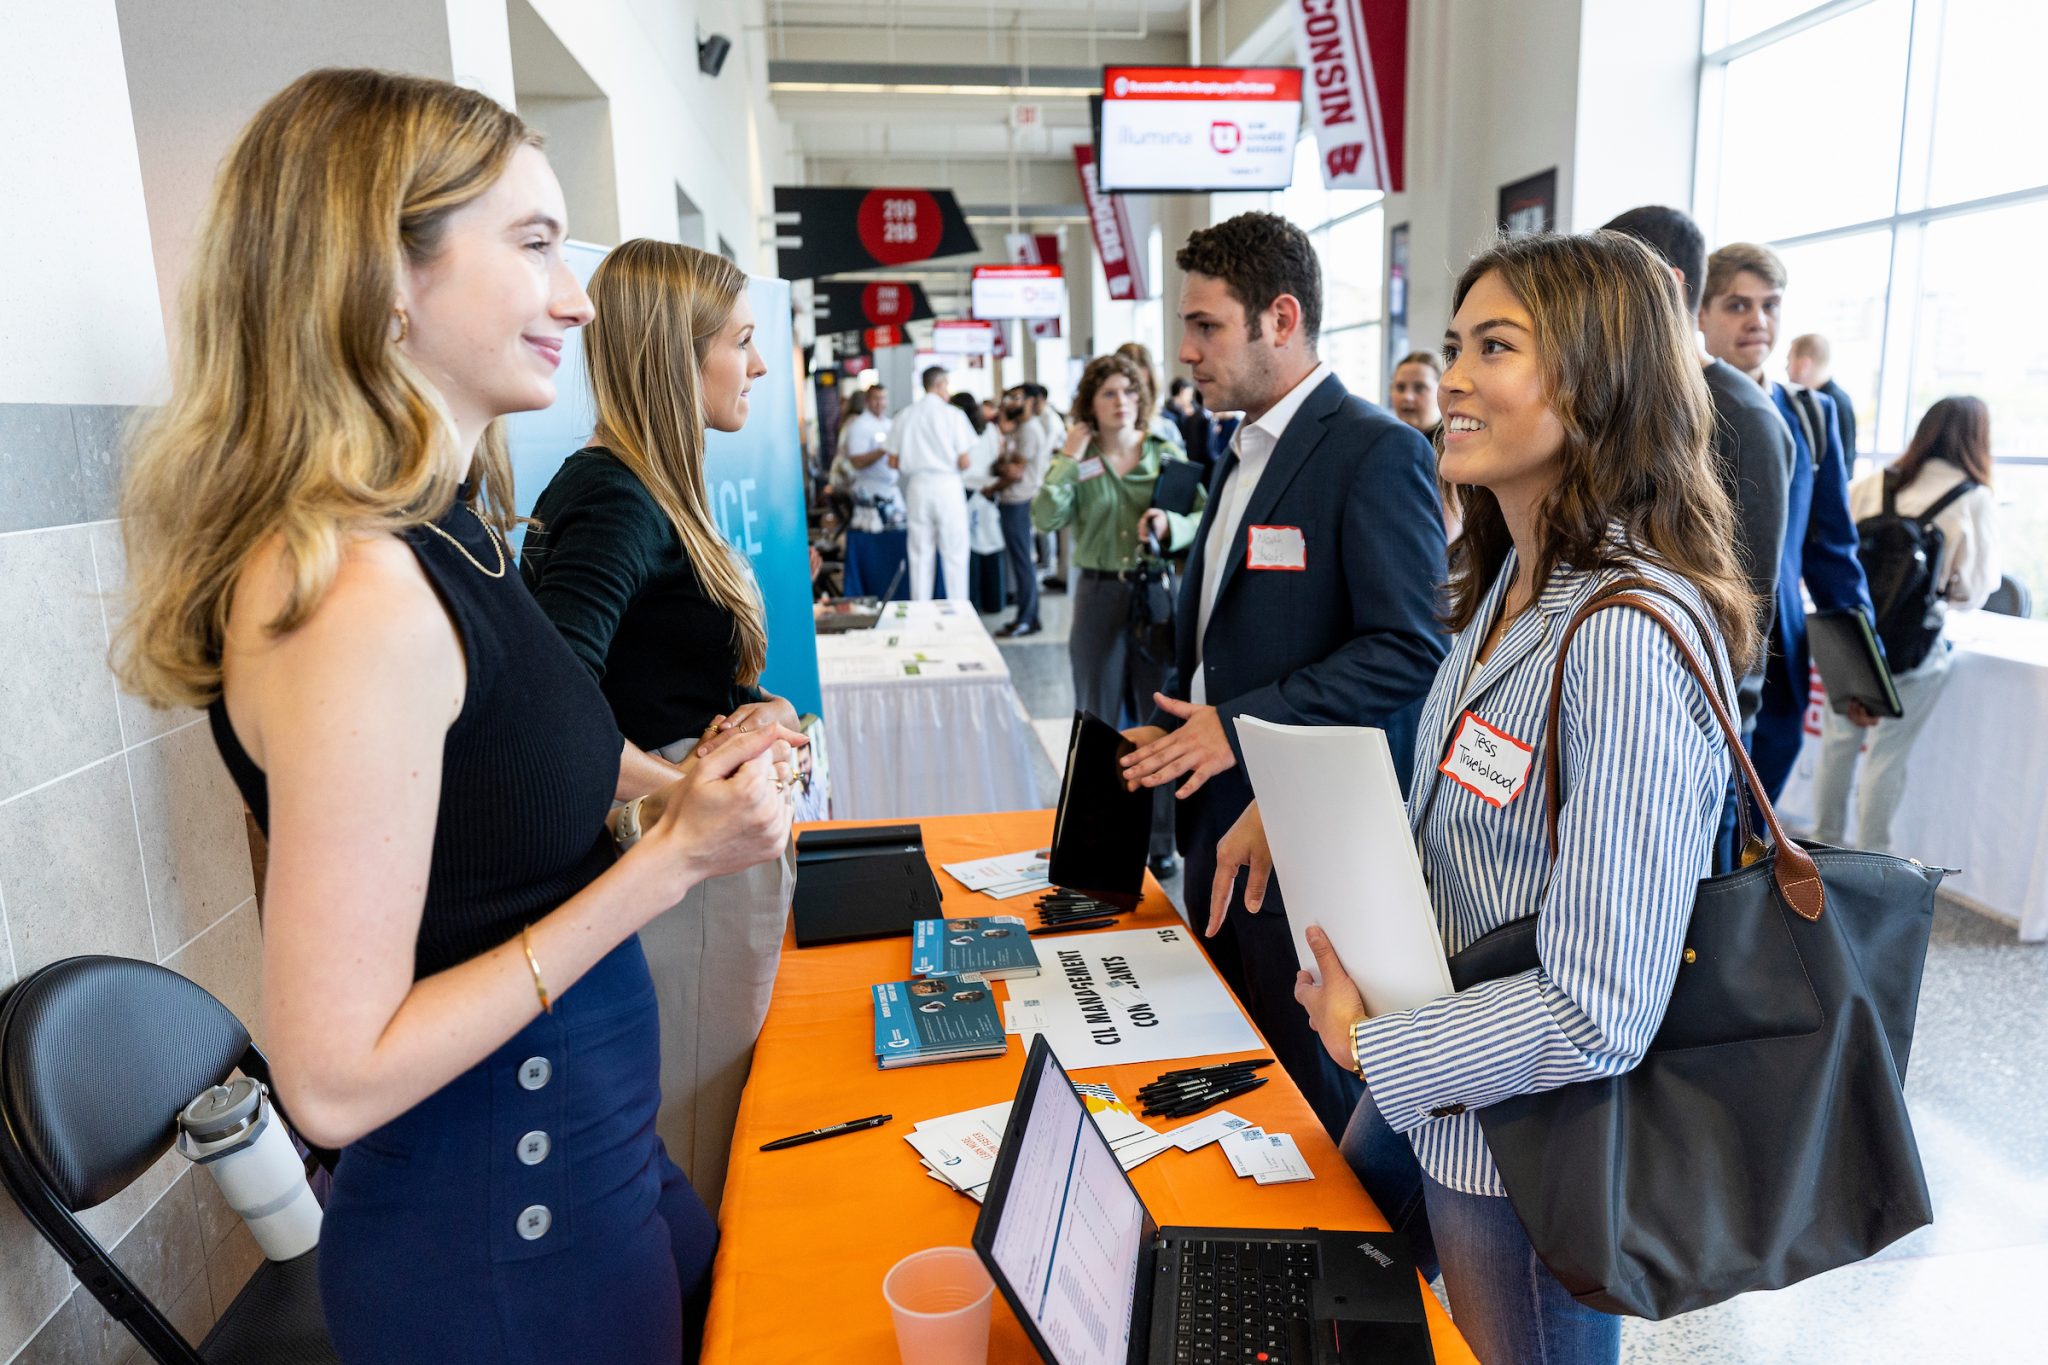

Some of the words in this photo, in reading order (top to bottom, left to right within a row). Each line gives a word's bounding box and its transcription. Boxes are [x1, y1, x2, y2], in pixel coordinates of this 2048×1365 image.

[1473, 729, 1498, 757] Tess
[1460, 744, 1517, 794] Trueblood
[1157, 929, 1180, 943] 215
[1057, 950, 1112, 1024] MANAGEMENT
[1101, 956, 1159, 1028] CONANTS
[1091, 1026, 1122, 1045] CIL
[1356, 1242, 1394, 1268] ThinkPad
